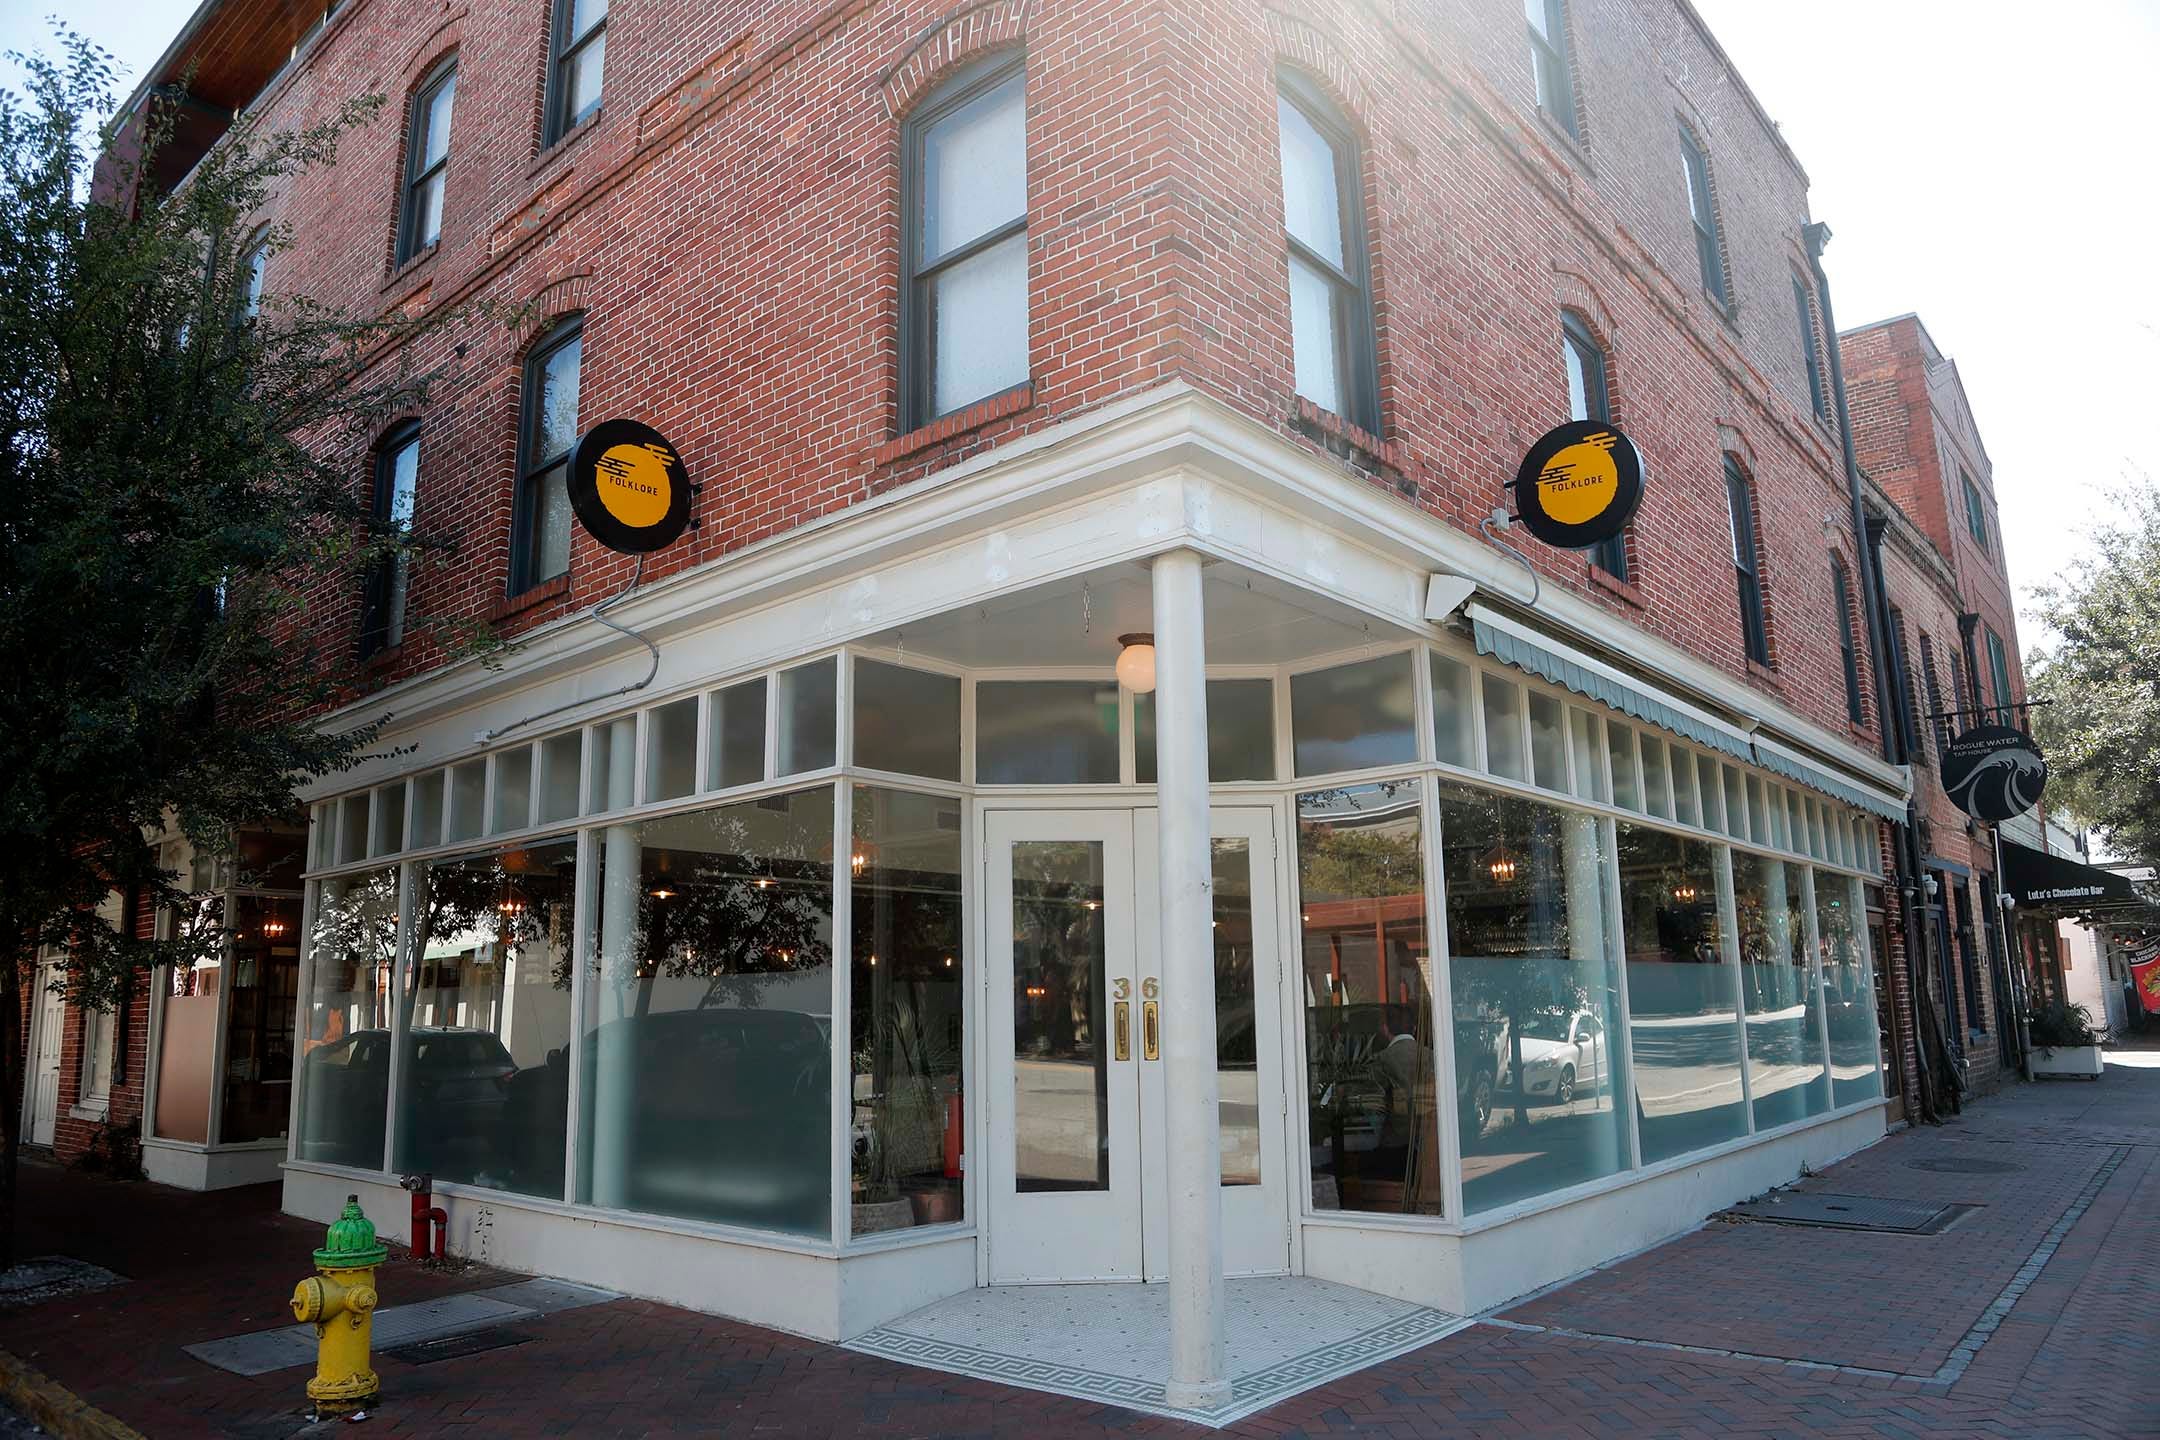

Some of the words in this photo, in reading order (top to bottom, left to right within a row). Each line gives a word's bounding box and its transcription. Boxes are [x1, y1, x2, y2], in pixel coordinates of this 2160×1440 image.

[609, 476, 658, 496] FOLKLORE
[1552, 475, 1603, 493] FOLKLORE
[1952, 740, 1985, 751] ROGUE
[1986, 737, 2018, 747] WATER
[1967, 748, 1992, 756] HOUSE
[2052, 886, 2089, 898] Chocolate
[2090, 885, 2105, 895] Bar
